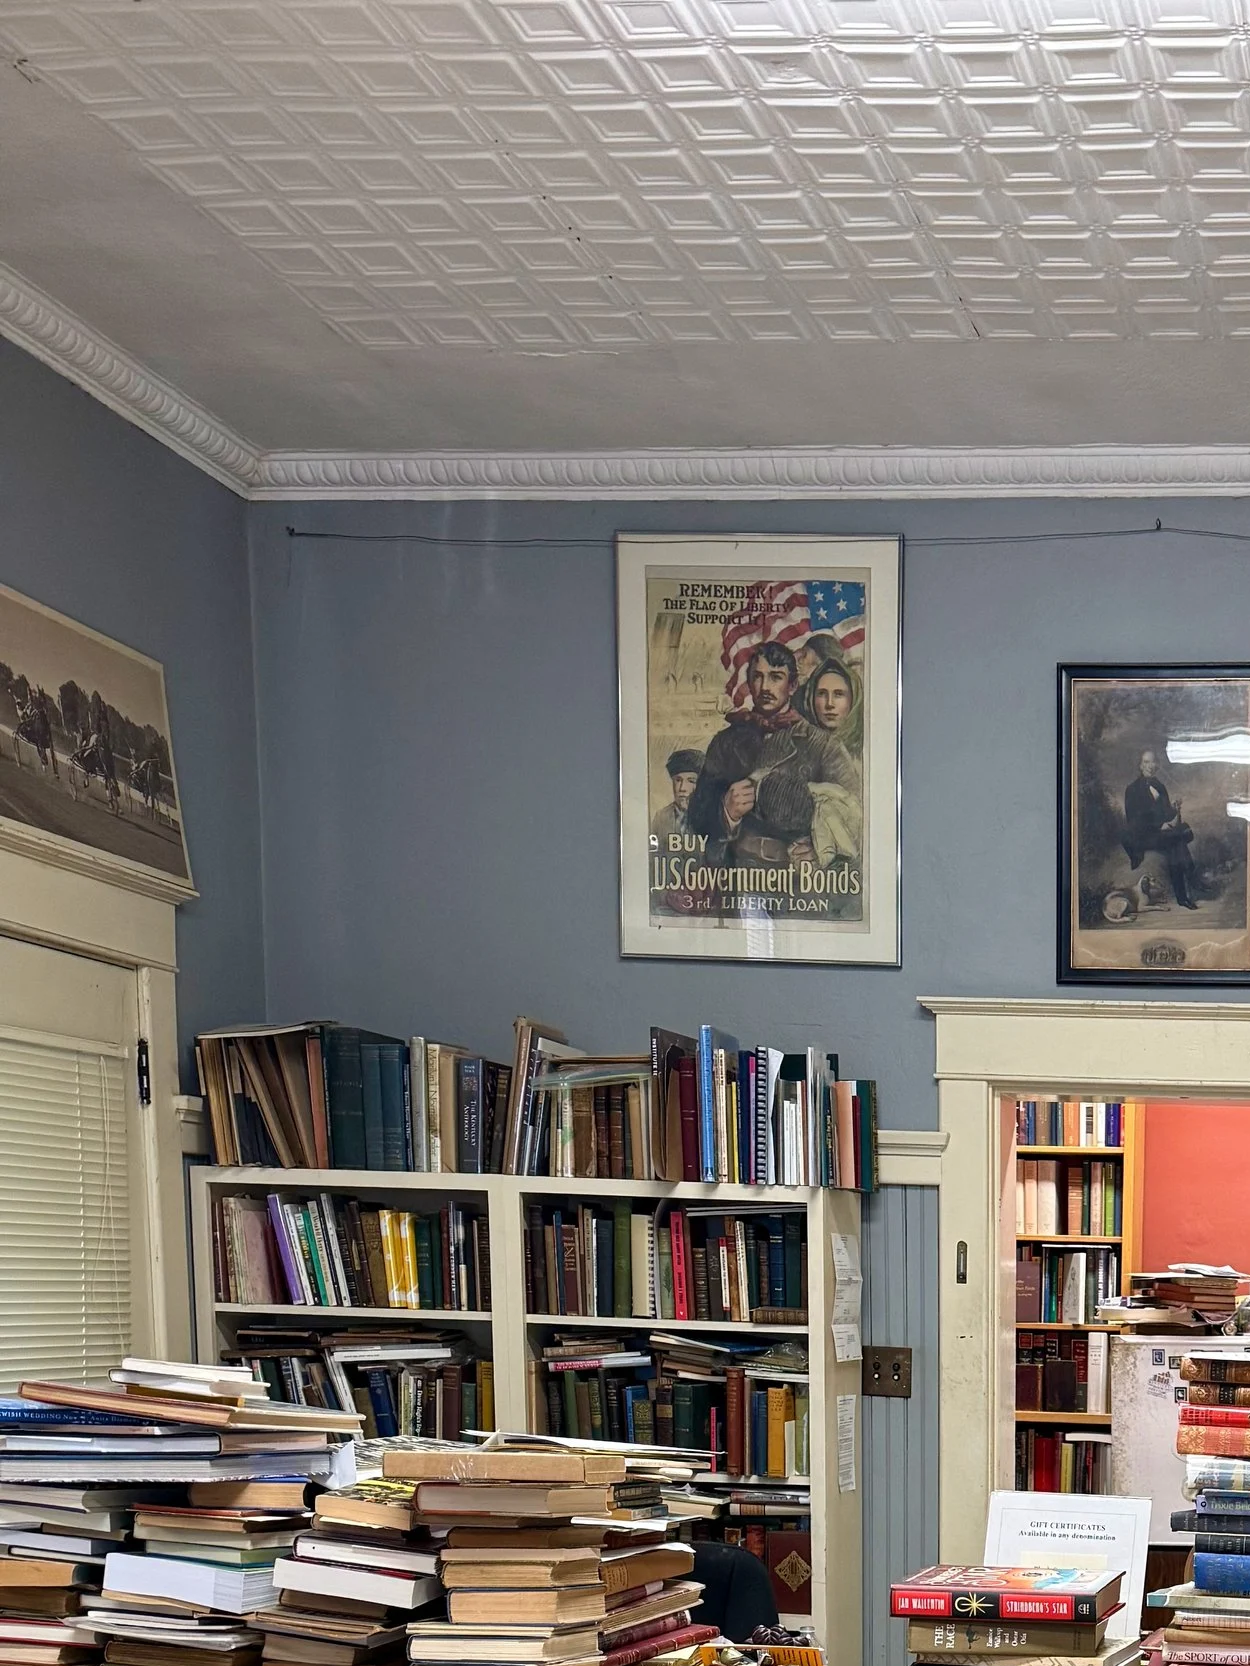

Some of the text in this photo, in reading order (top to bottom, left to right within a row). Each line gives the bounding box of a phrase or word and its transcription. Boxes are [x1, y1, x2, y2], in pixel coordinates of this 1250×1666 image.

[679, 583, 773, 598] REMEMBER!
[663, 599, 737, 612] THE FLAG OF
[687, 612, 743, 626] SUPPORT
[668, 834, 708, 852] BUY
[800, 861, 861, 894] Bonds
[722, 897, 828, 912] LIBERTY LOAN
[1050, 1522, 1105, 1531] CERTIFICATES
[935, 1626, 944, 1646] THE
[946, 1624, 955, 1649] RACE
[1168, 1652, 1183, 1661] The
[1184, 1653, 1218, 1662] SPORT
[1220, 1654, 1231, 1665] of
